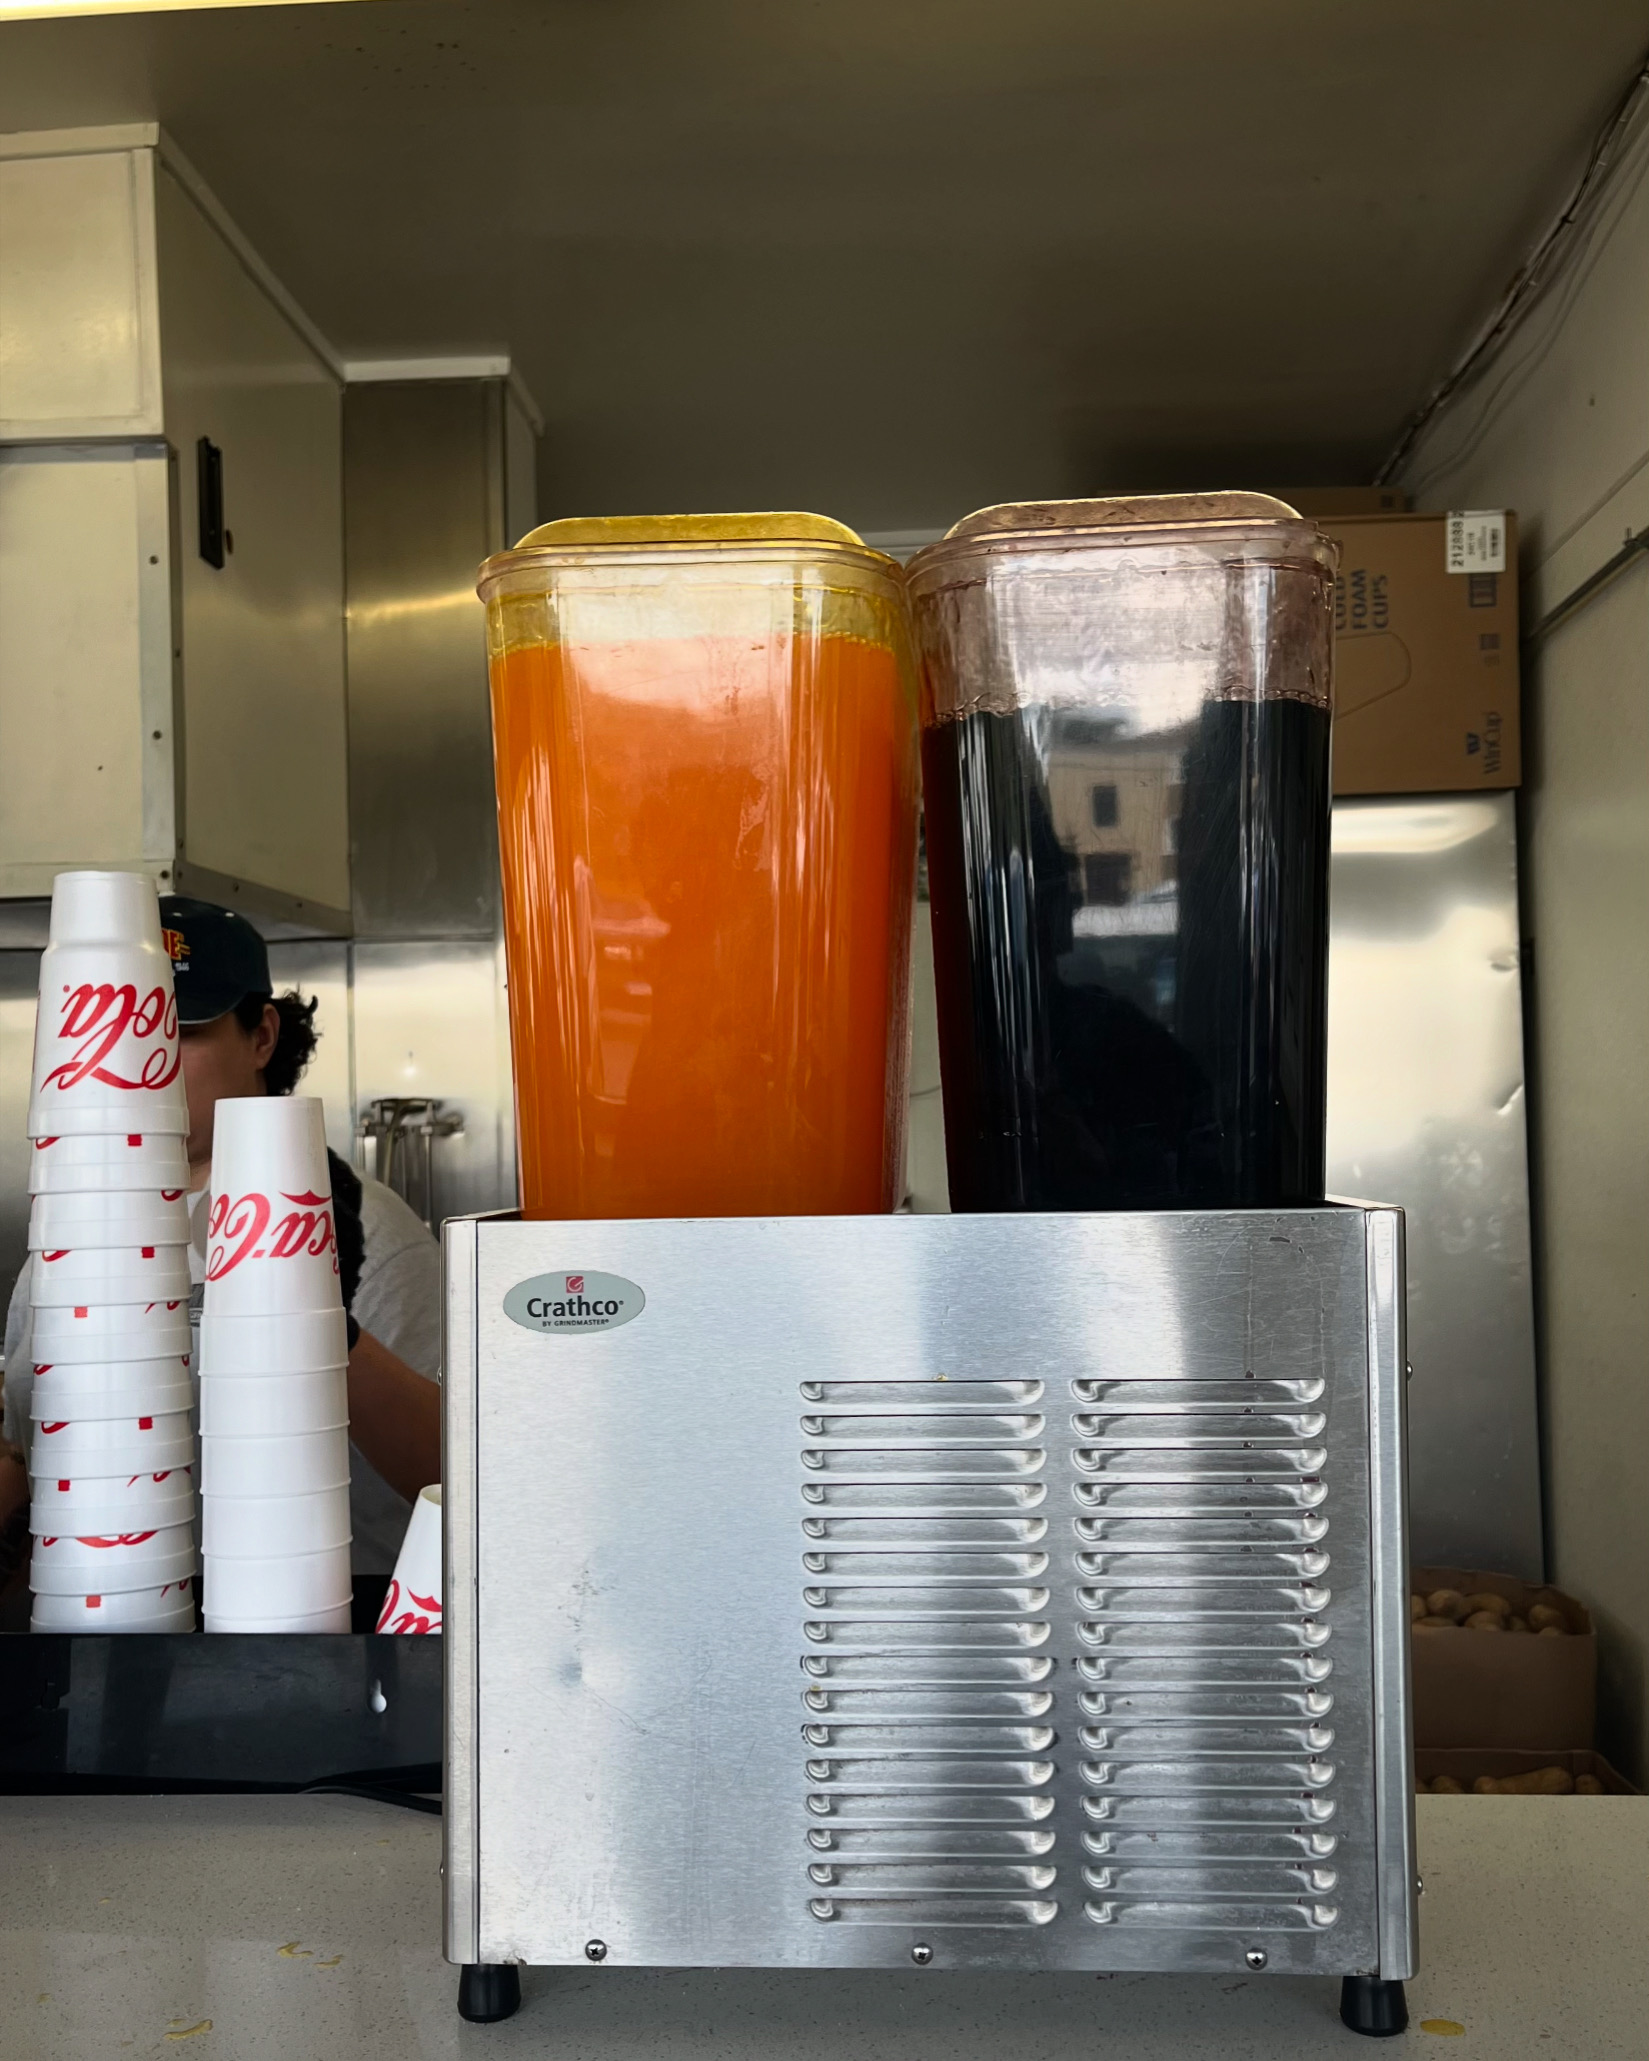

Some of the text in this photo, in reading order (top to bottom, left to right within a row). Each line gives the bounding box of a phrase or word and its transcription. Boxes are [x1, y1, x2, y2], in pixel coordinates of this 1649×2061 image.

[1351, 569, 1367, 630] FOAM
[1372, 574, 1389, 630] CUPS
[527, 1295, 619, 1318] Crathco
[554, 1319, 605, 1327] GRINDMASTER
